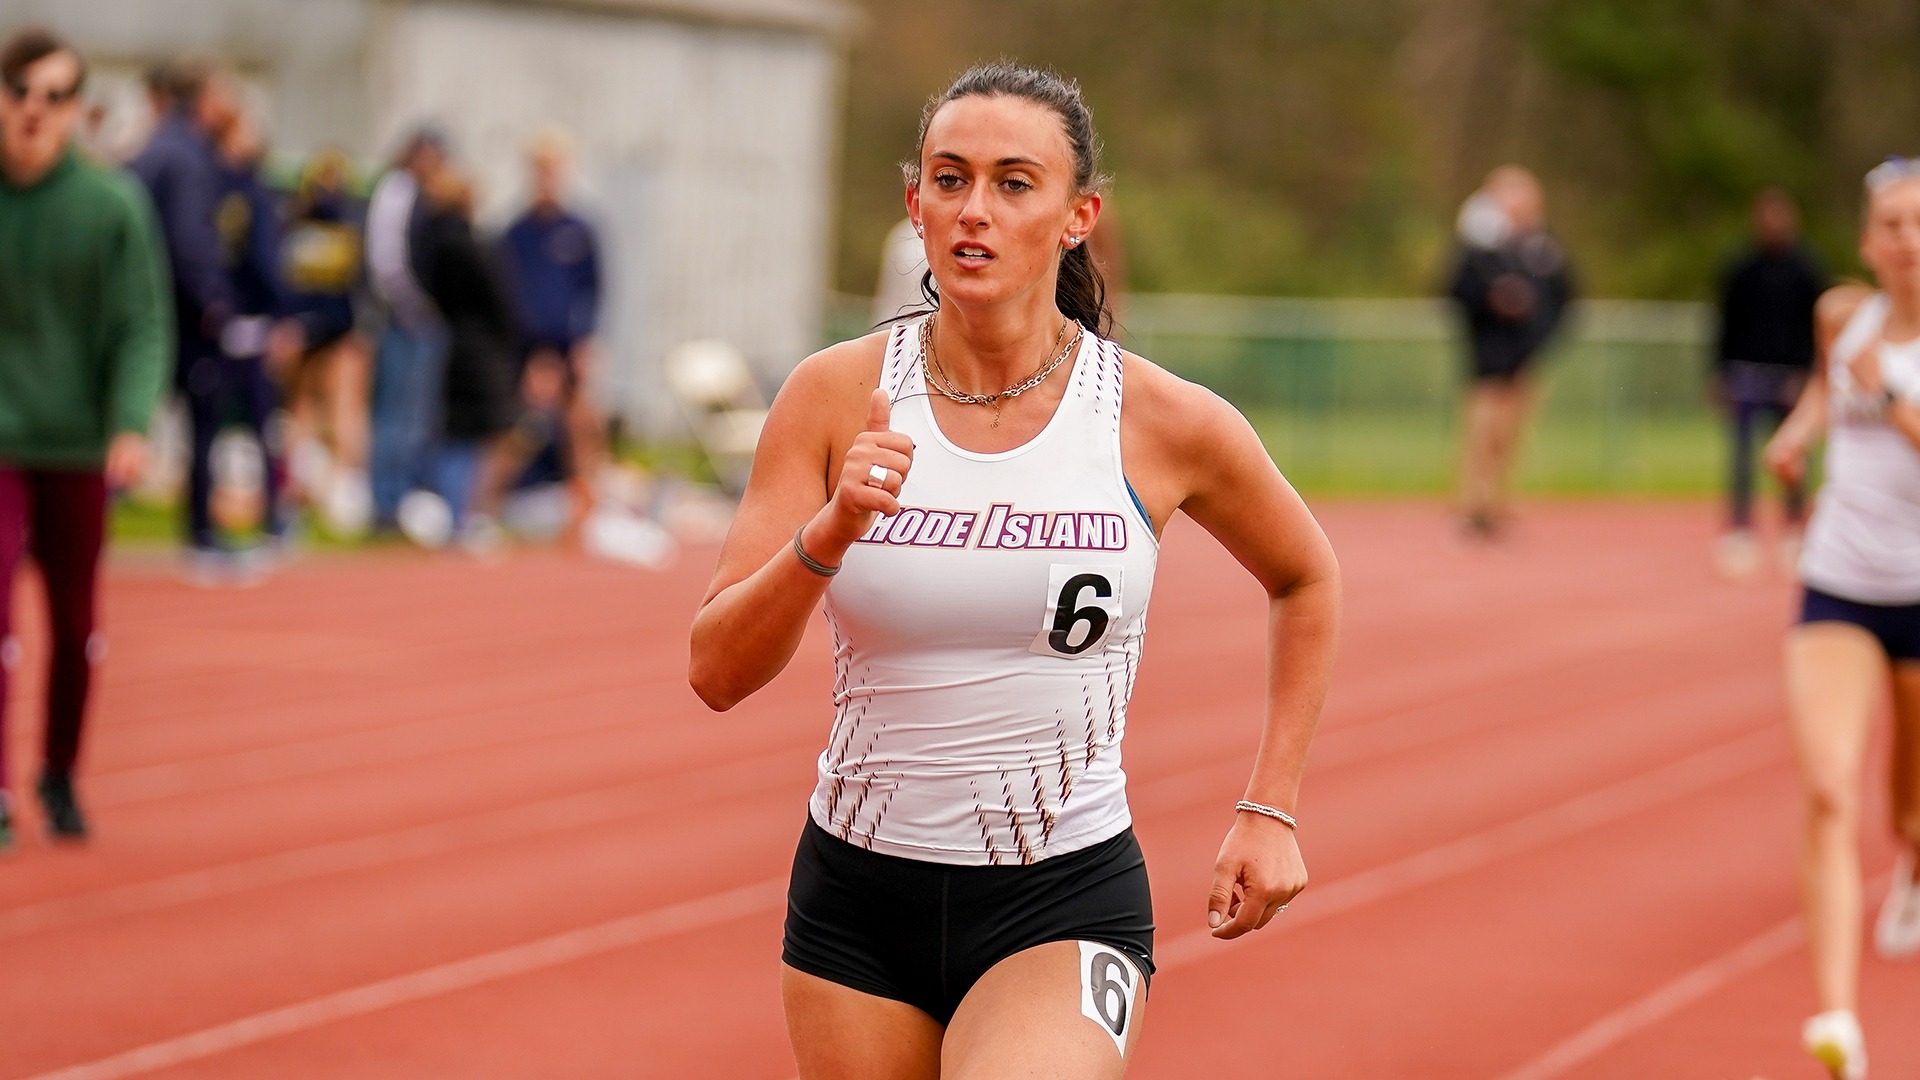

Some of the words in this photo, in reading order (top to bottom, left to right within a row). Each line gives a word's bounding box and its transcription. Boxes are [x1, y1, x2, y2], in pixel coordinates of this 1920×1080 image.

[857, 507, 977, 547] HODE
[977, 504, 1127, 550] ISLAND
[1048, 573, 1112, 654] 6
[1090, 951, 1130, 1036] 6
